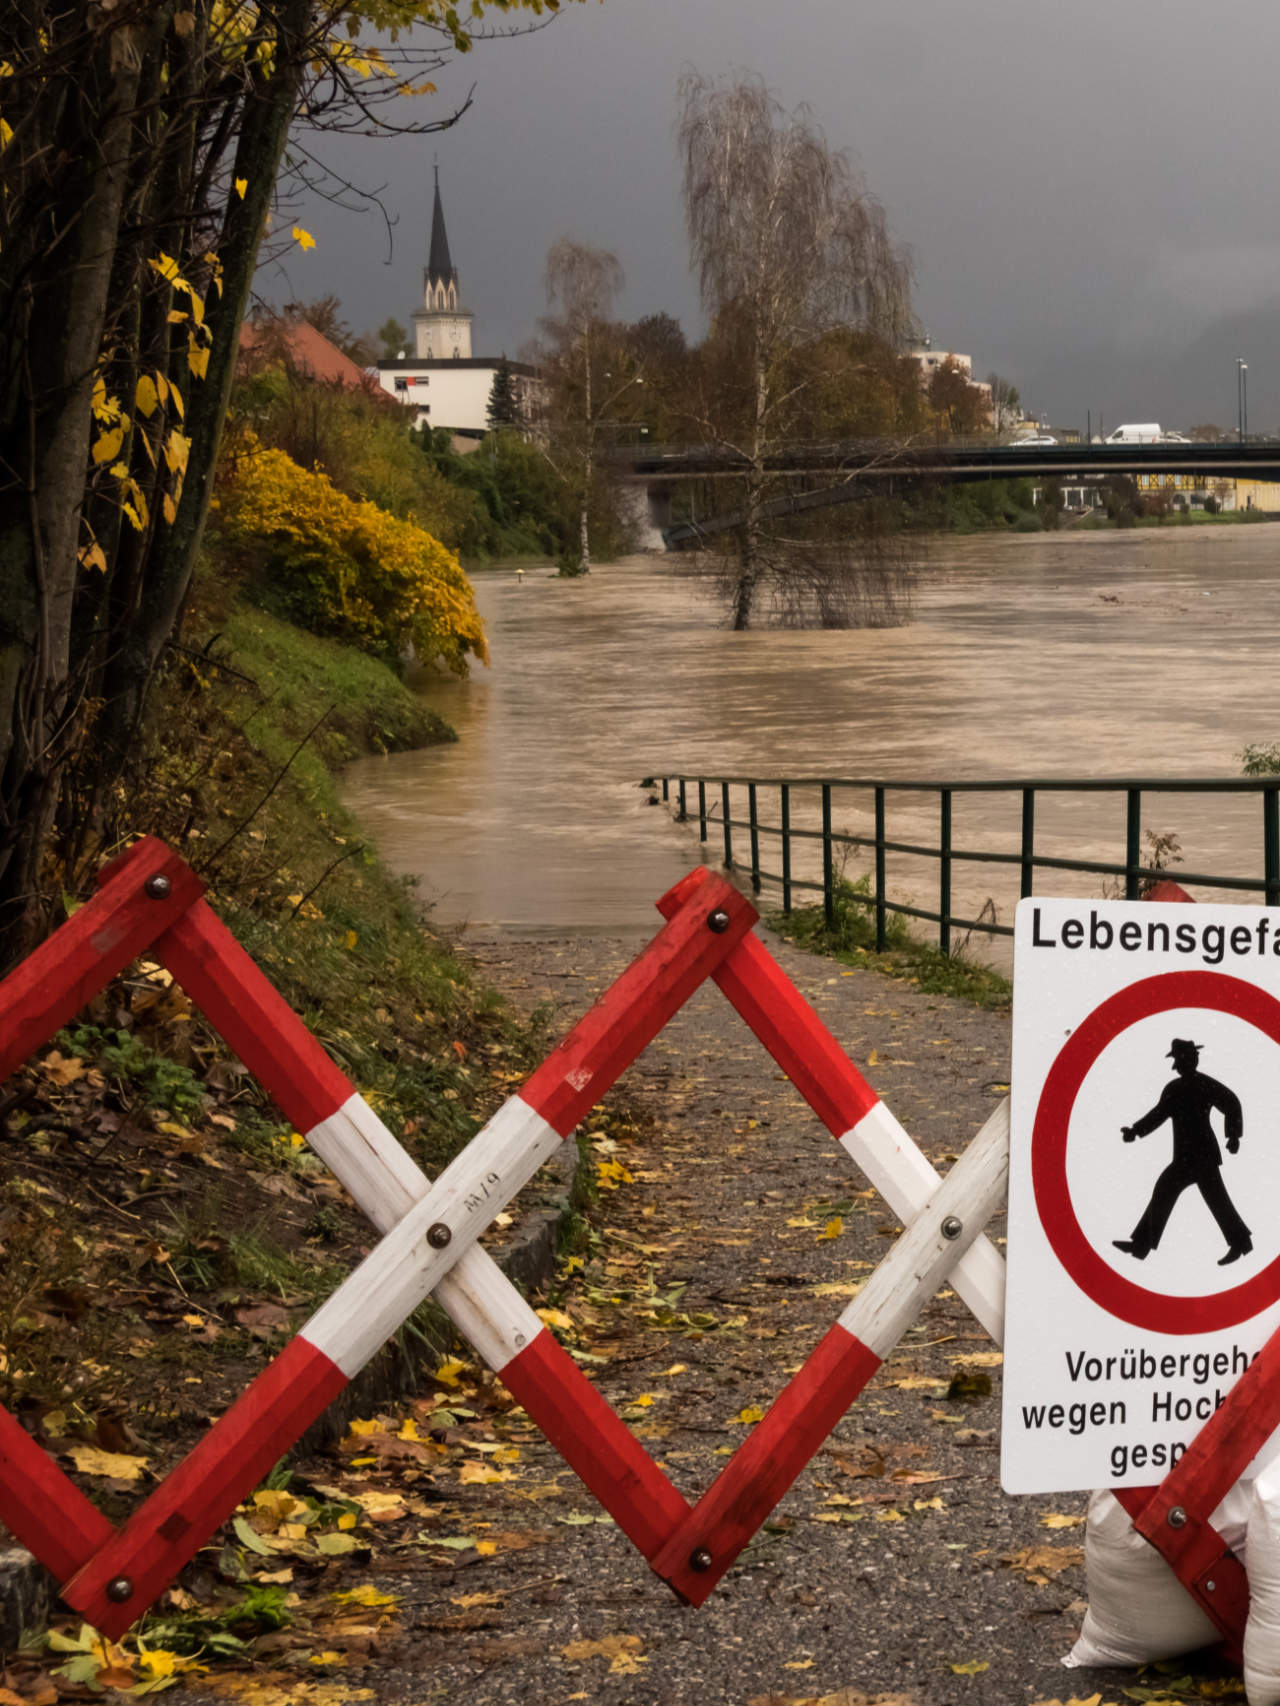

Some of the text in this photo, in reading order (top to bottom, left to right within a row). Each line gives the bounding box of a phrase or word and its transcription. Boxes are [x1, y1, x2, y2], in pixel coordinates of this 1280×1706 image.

[1065, 1345, 1260, 1384] Vorübergeh
[1022, 1402, 1126, 1435] wegen
[1110, 1442, 1188, 1477] gesp
